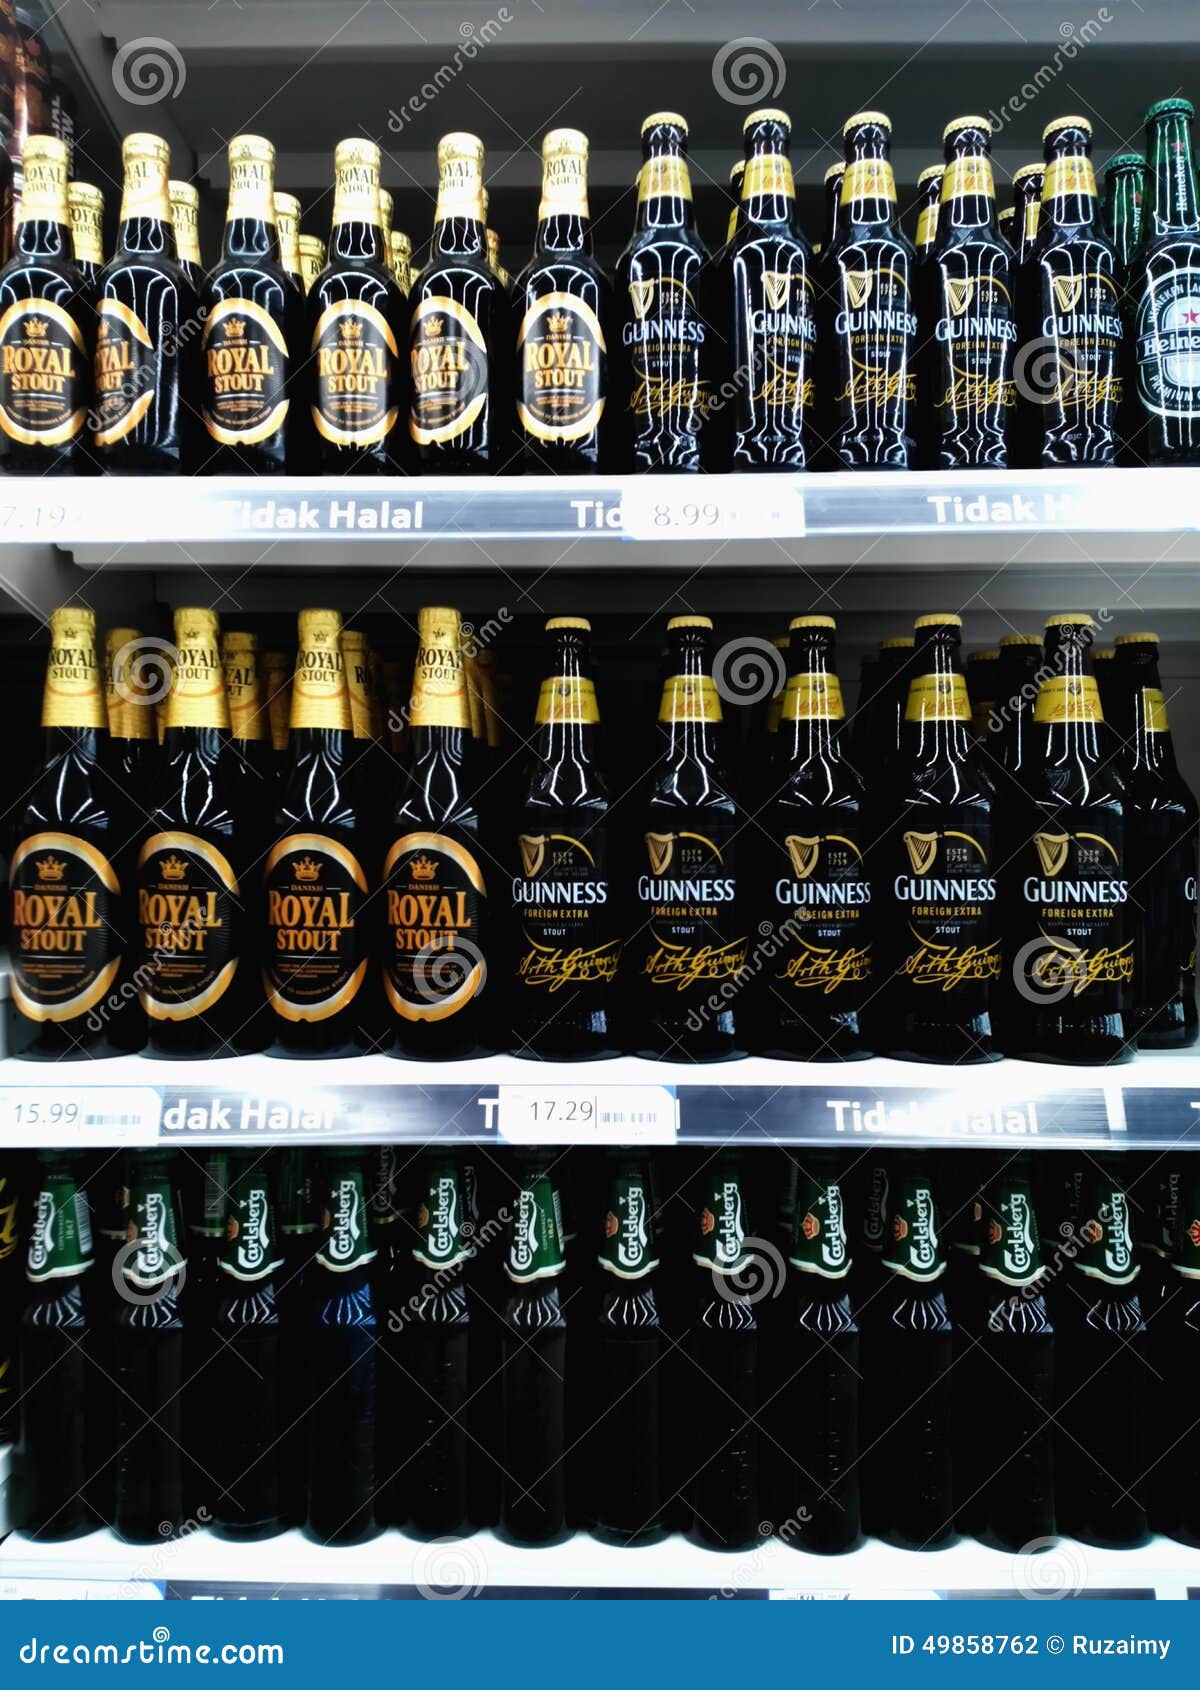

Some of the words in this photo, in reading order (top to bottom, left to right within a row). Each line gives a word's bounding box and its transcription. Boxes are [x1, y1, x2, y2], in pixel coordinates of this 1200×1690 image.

[1175, 155, 1188, 212] Heineken
[622, 318, 705, 345] GUINNESS
[835, 310, 918, 336] GUINNESS
[935, 318, 1018, 342] GUINNESS
[1042, 315, 1124, 340] GUINNESS
[2, 345, 76, 378] ROYAL
[96, 341, 136, 375] YAL
[207, 344, 274, 377] ROYAL
[319, 347, 388, 378] ROYAL
[525, 341, 594, 372] ROYAL
[11, 372, 66, 393] STOUT
[214, 373, 265, 393] STOUT
[328, 375, 379, 394] STOUT
[535, 369, 586, 389] STOUT
[225, 500, 321, 529] Tidak
[329, 500, 424, 529] Halal
[653, 503, 720, 527] 8.99
[926, 495, 1039, 523] Tidak
[176, 648, 218, 669] OYAL
[299, 649, 343, 672] ROYAL
[52, 667, 90, 680] STOUT
[301, 668, 337, 683] STOUT
[421, 667, 457, 681] STOUT
[291, 884, 323, 892] DANISH
[408, 883, 440, 891] DANISH
[512, 877, 608, 904] GUINNESS
[638, 875, 736, 901] GUINNESS
[775, 878, 871, 904] GUINNESS
[894, 875, 997, 901] GUINNESS
[1024, 876, 1128, 903] GUINNESS
[13, 889, 102, 928] ROYAL
[139, 888, 222, 928] ROYAL
[268, 889, 355, 928] ROYAL
[387, 889, 472, 928] ROYAL
[524, 908, 558, 919] FOREIGN
[560, 908, 589, 919] EXTRA
[651, 906, 687, 917] FOREIGN
[689, 906, 718, 917] EXTRA
[835, 909, 860, 919] EXTRA
[911, 906, 952, 916] FOREIGN
[954, 906, 982, 916] EXTRA
[1042, 908, 1084, 918] FOREIGN
[1086, 908, 1114, 918] EXTRA
[20, 928, 87, 951] STOUT
[145, 928, 208, 951] STOUT
[277, 928, 342, 951] STOUT
[396, 928, 458, 951] STOUT
[543, 928, 566, 936] STOUT
[671, 926, 696, 934] STOUT
[817, 929, 841, 937] STOUT
[935, 926, 960, 934] STOUT
[1067, 928, 1092, 936] STOUT
[11, 1102, 79, 1124] 15.99
[162, 1098, 233, 1130] dak
[528, 1100, 594, 1122] 17.29
[28, 1191, 55, 1270] Carlsberg
[237, 1189, 270, 1269] Carlsberg
[330, 1180, 361, 1260] Carlsberg
[428, 1178, 459, 1257] Carlsberg
[511, 1190, 539, 1271] Carlsberg
[618, 1186, 648, 1267] Carlsberg
[716, 1182, 745, 1263] Carlsberg
[822, 1185, 847, 1267] Carlsberg
[910, 1188, 938, 1269] Carlsberg
[137, 1193, 170, 1273] Carlsberg
[1004, 1193, 1035, 1273] Carlsberg
[1105, 1192, 1133, 1272] Carlsberg
